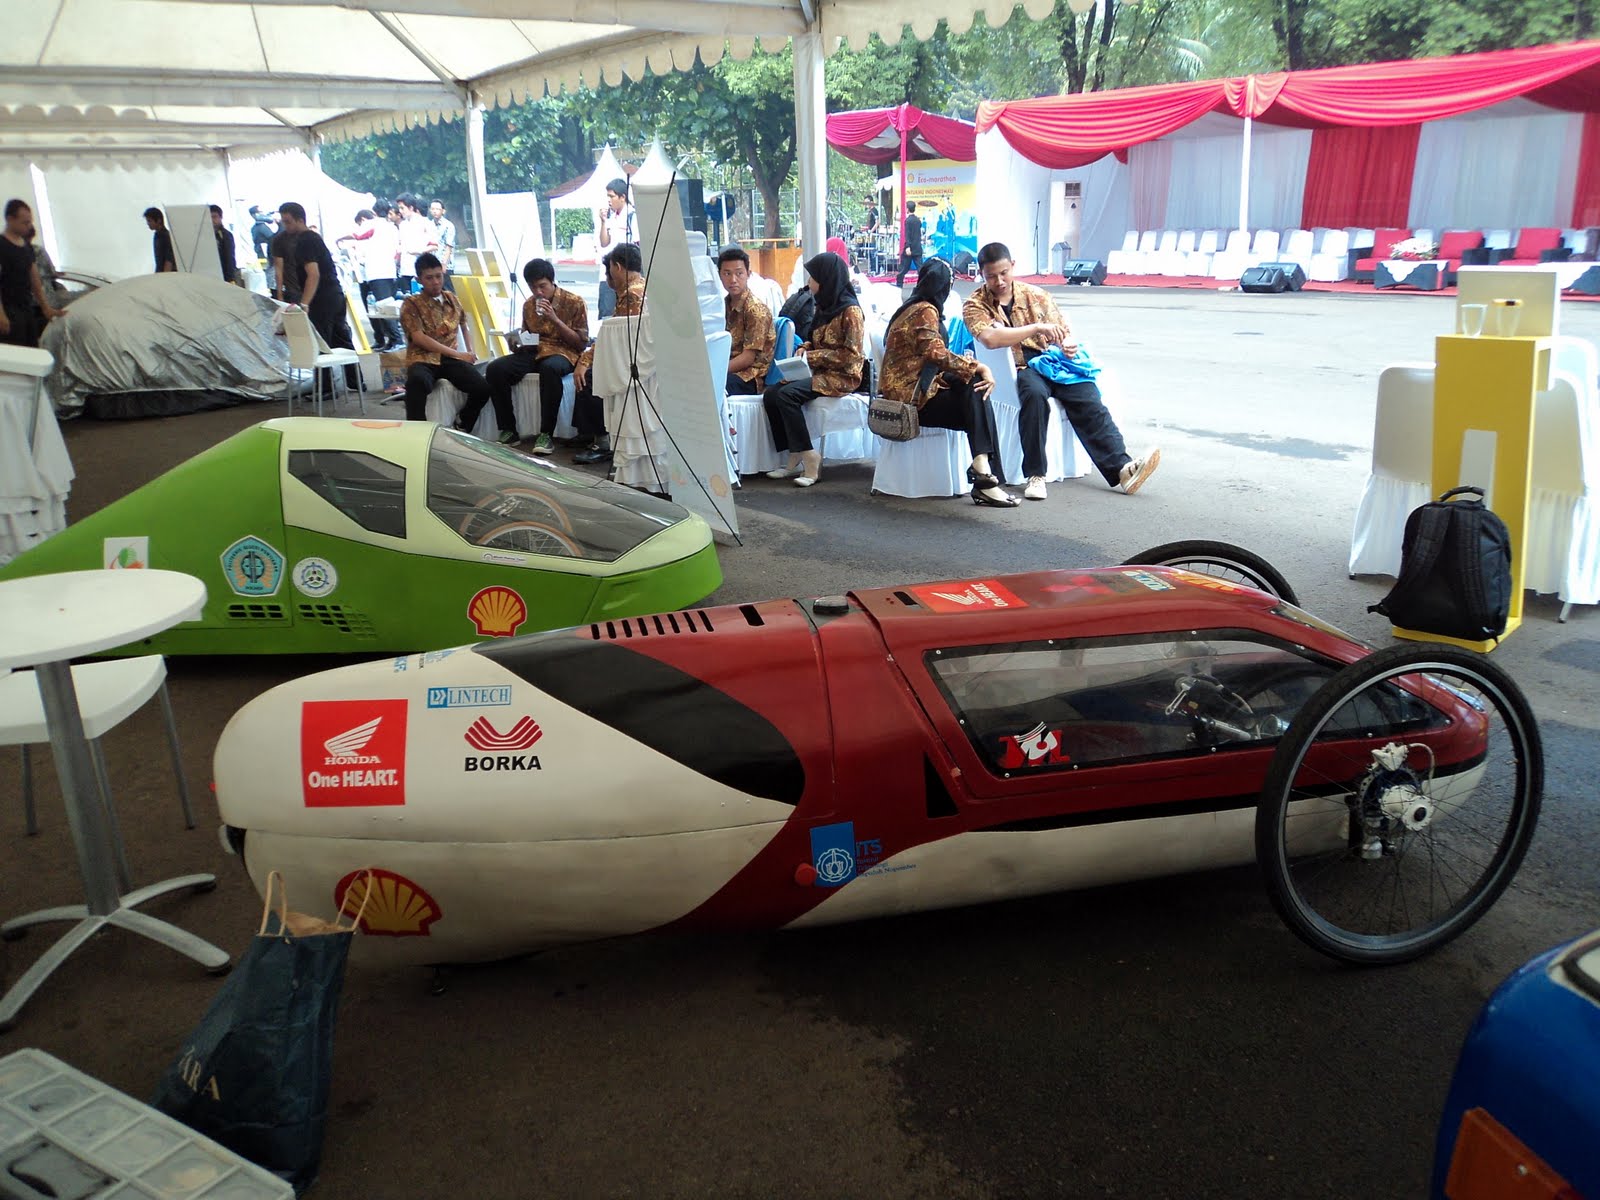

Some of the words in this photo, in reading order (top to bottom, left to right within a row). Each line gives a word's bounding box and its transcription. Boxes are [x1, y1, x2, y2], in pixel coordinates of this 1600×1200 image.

[449, 688, 509, 704] LINTECH
[324, 756, 381, 765] HONDA
[464, 756, 542, 771] BORKA
[308, 771, 340, 788] One
[342, 769, 398, 787] HEART.
[856, 839, 882, 856] ITS
